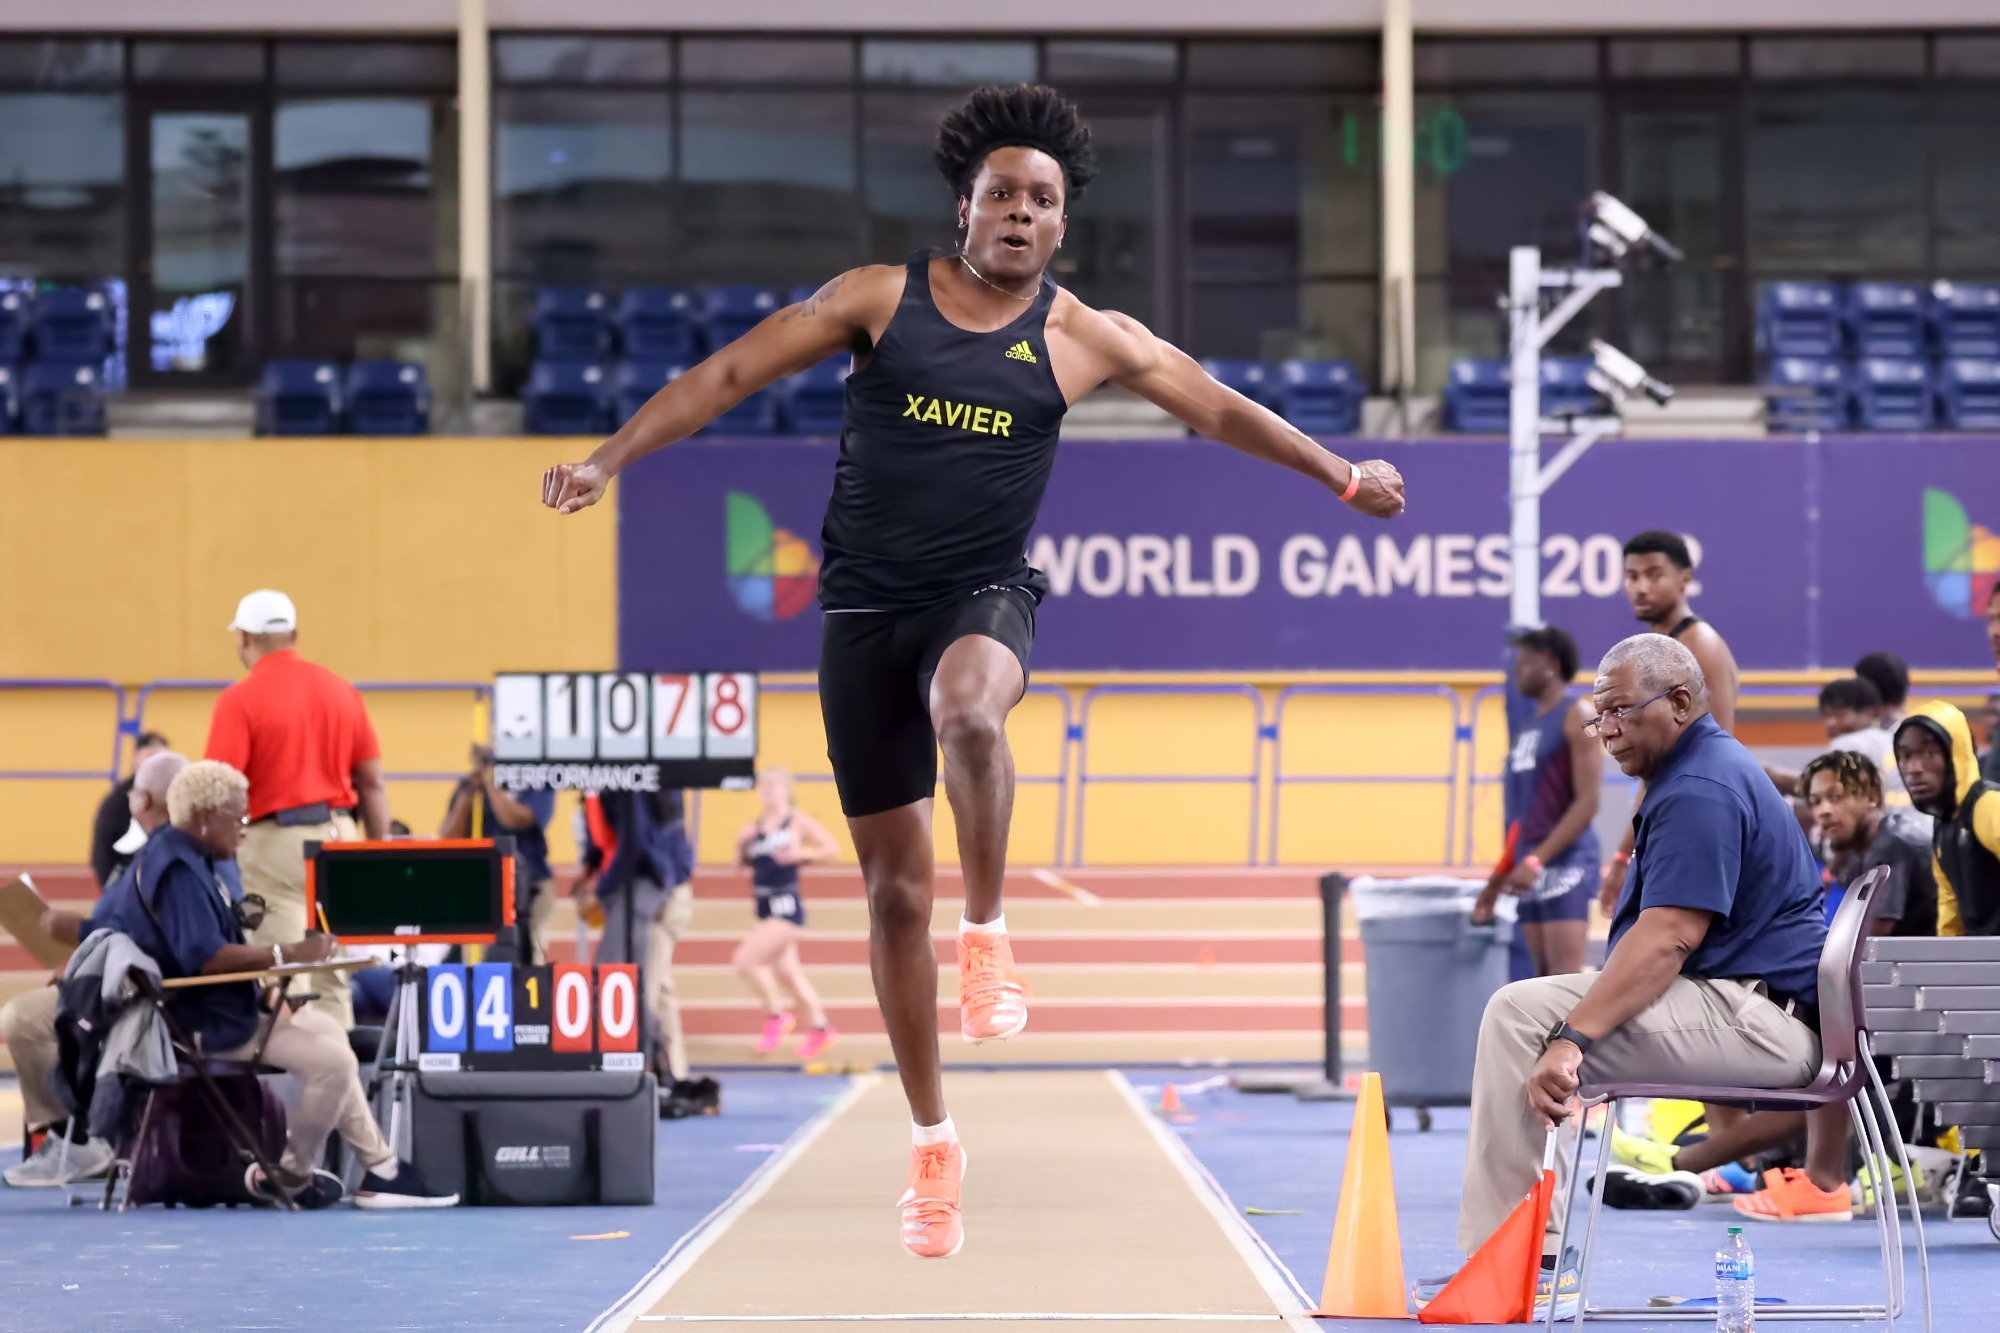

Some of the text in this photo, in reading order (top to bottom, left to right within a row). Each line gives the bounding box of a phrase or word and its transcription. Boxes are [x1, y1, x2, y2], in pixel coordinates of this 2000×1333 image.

[1005, 350, 1037, 364] adidas
[902, 393, 1014, 438] XAVIER
[1025, 533, 1261, 598] WORLD
[1279, 533, 1514, 598] GAMES
[494, 763, 660, 792] PERFORMANCE
[430, 971, 511, 1041] 04
[525, 975, 540, 1010] 1
[555, 971, 636, 1039] 00
[1542, 1273, 1577, 1294] HKA
